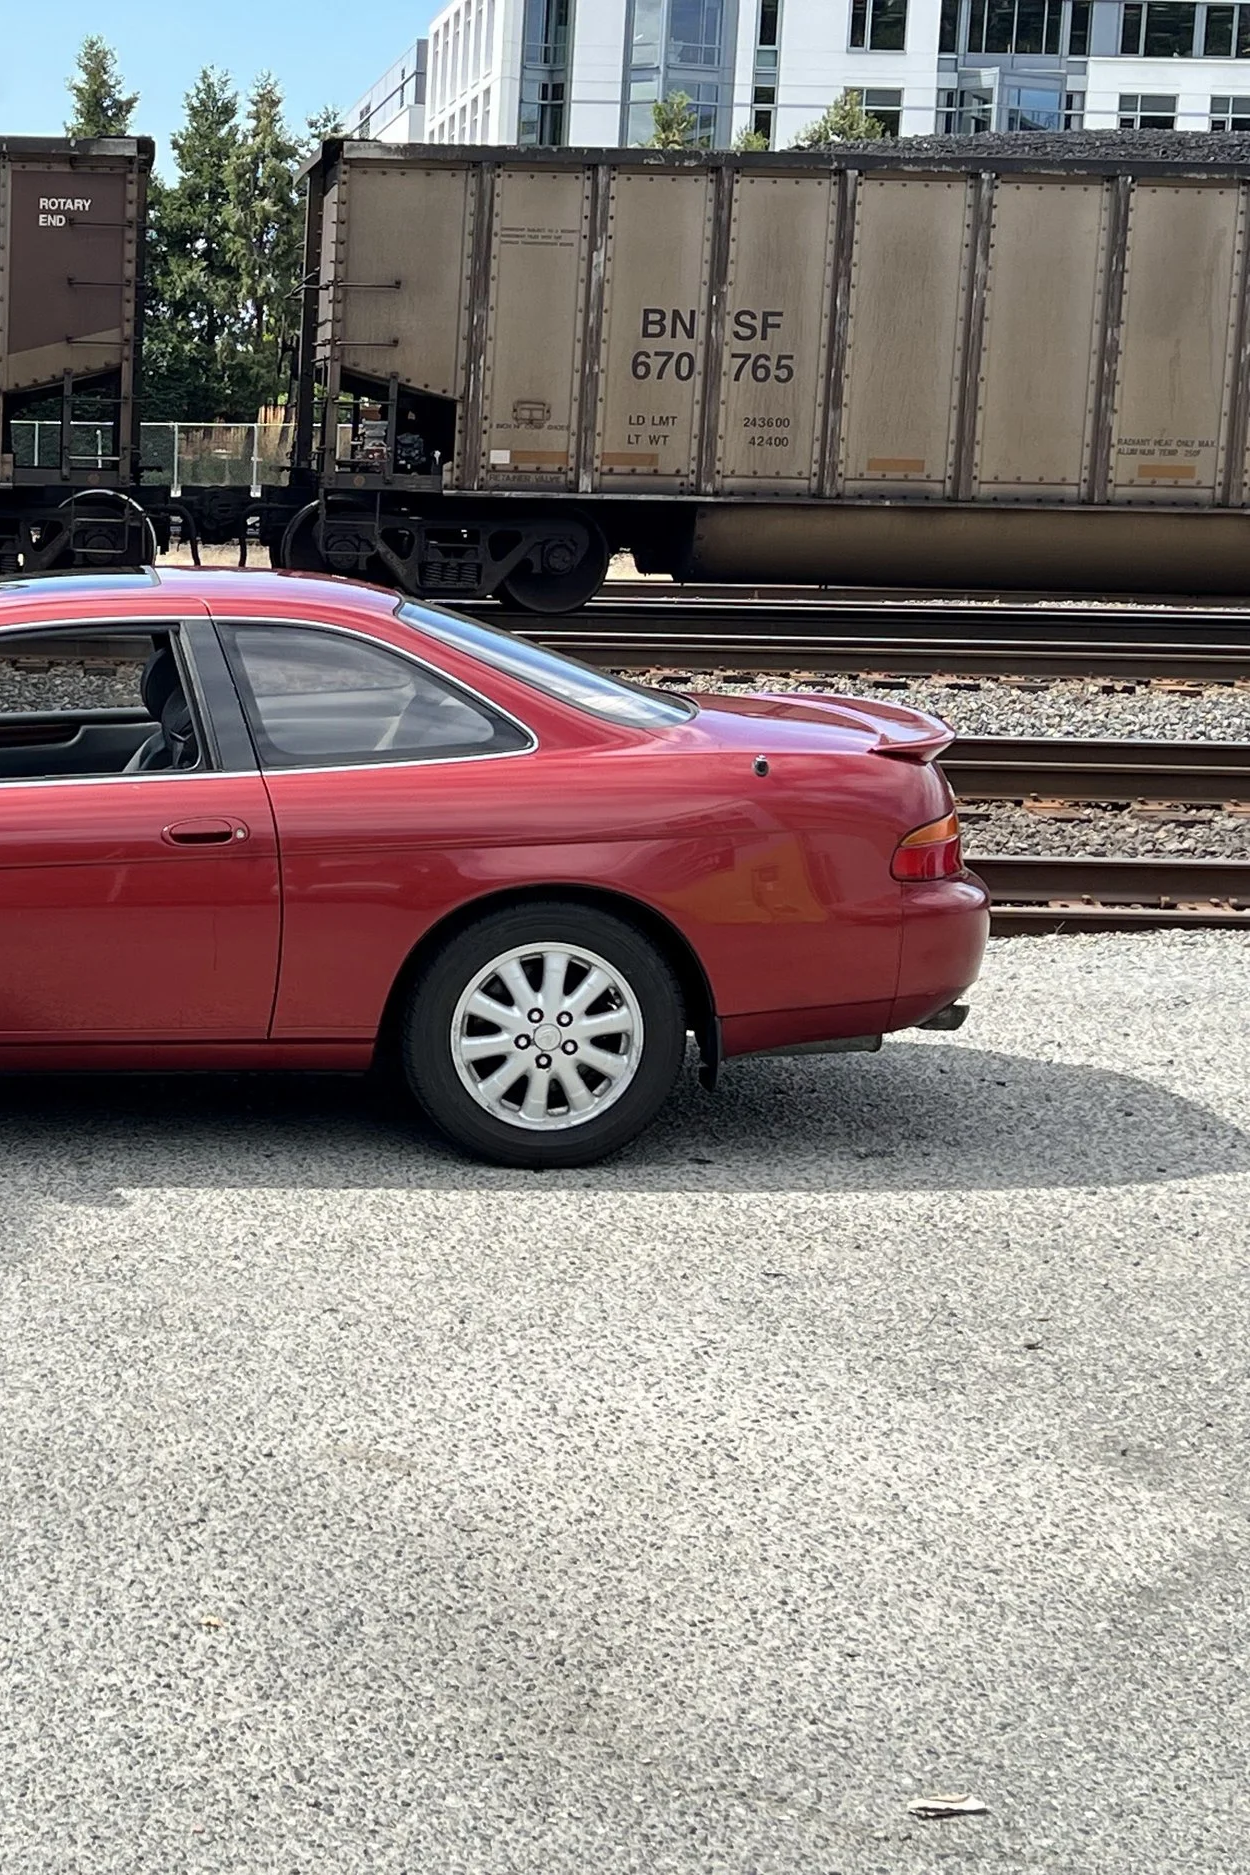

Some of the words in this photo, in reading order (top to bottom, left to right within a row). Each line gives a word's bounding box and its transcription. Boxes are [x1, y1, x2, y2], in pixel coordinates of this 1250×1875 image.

[39, 197, 92, 211] ROTARY
[38, 214, 66, 227] END
[641, 308, 696, 339] BN
[732, 309, 784, 341] SF
[631, 350, 695, 381] 670
[731, 353, 794, 383] 765
[628, 415, 645, 426] LD
[651, 415, 678, 426] LMT
[743, 417, 790, 428] 243600
[627, 434, 642, 445] LT
[648, 434, 670, 446] WT
[748, 436, 789, 447] 42400
[1153, 439, 1173, 447] HEAT
[1117, 447, 1156, 456] ALUMNUM
